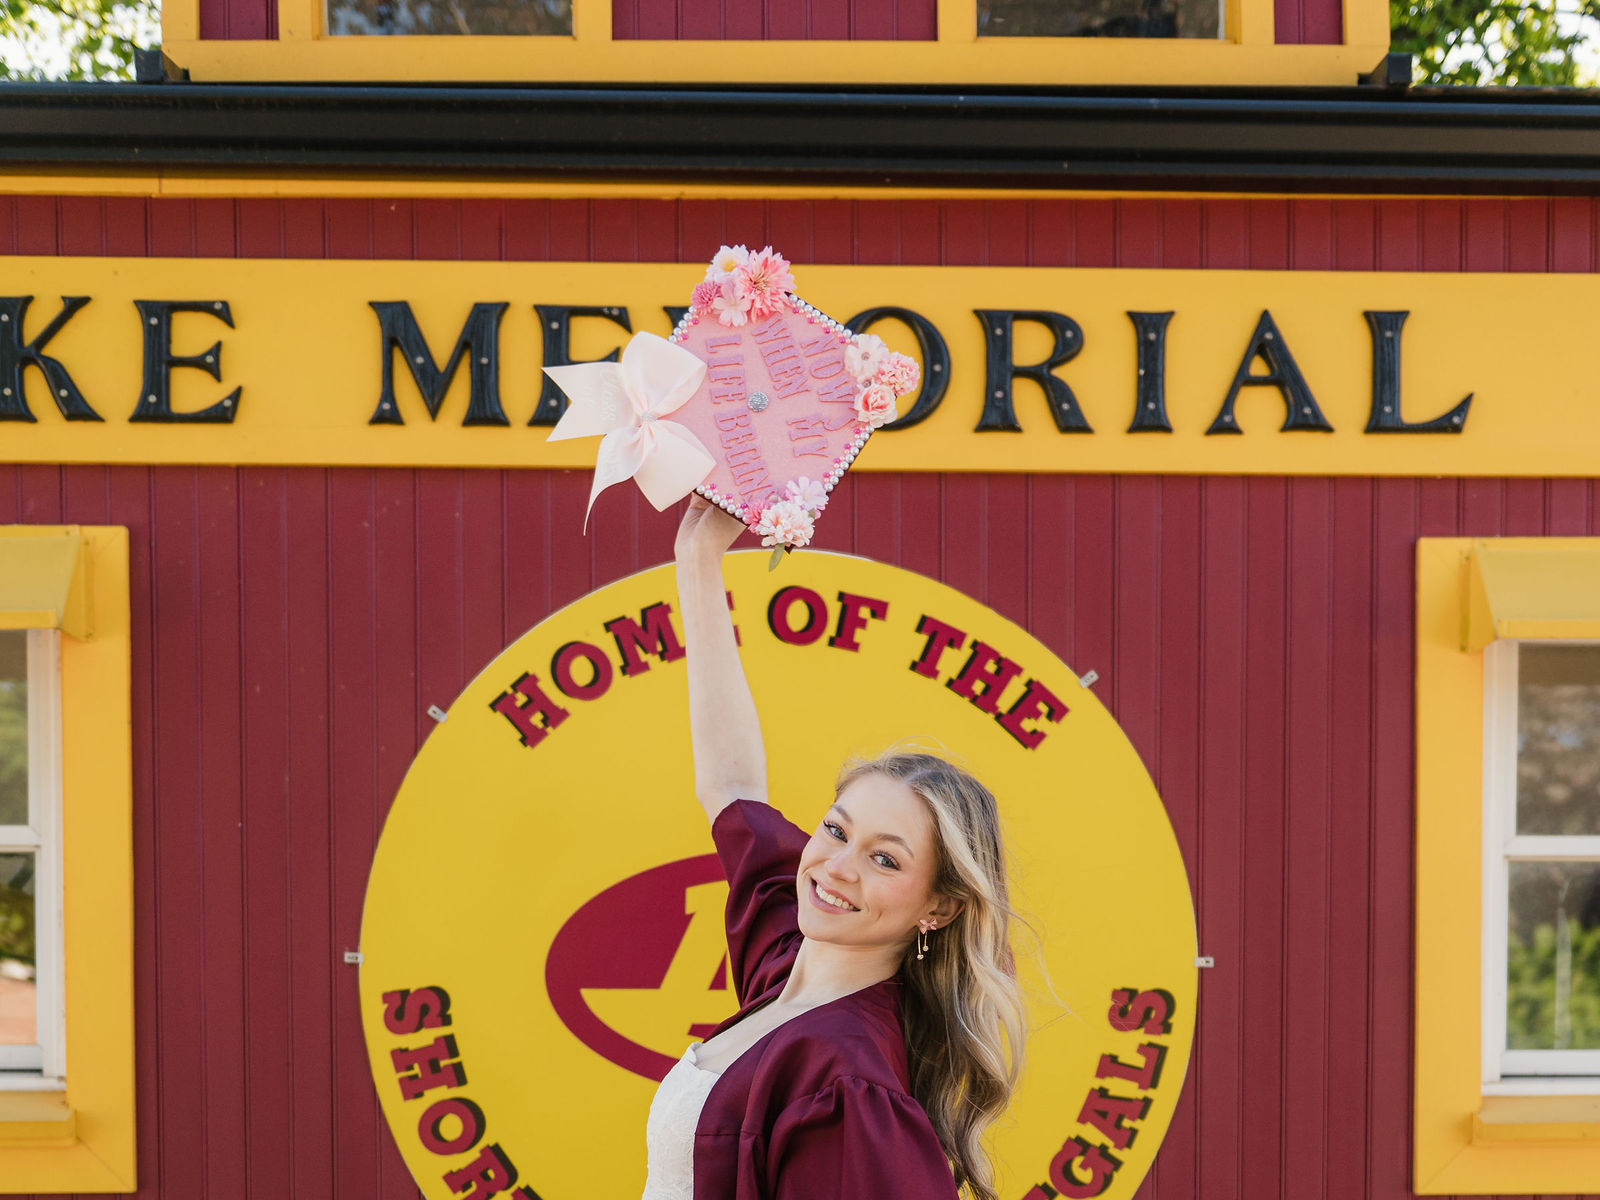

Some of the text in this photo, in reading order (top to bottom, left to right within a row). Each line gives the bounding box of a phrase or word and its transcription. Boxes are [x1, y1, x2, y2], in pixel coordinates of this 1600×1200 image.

[0, 295, 1475, 435] KE MEORIAL
[706, 334, 747, 405] LIFE
[751, 312, 829, 458] WHEN MY
[488, 585, 1070, 750] HOM OF THE
